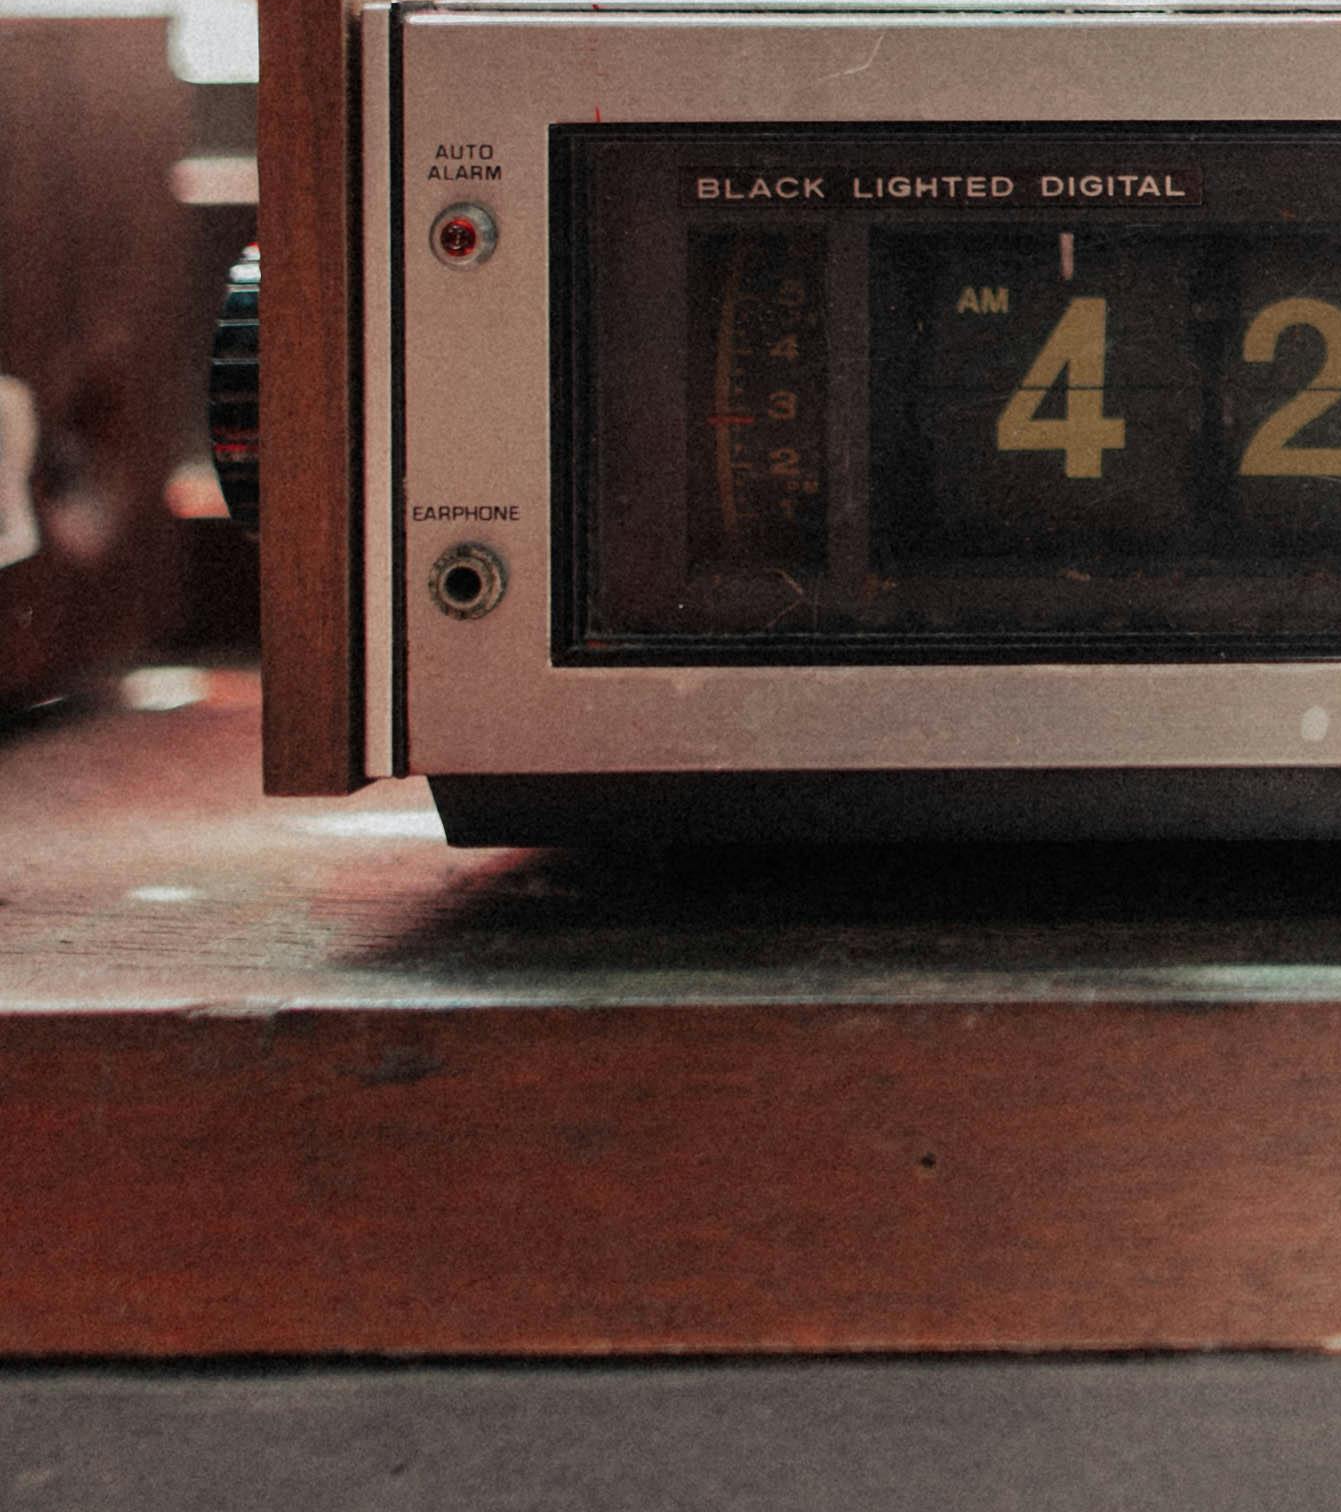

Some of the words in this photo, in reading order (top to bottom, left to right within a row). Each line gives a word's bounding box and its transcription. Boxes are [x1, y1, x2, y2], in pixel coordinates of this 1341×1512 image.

[434, 143, 494, 160] AUTO
[428, 164, 502, 181] ALARM
[697, 177, 825, 199] BLACK
[853, 176, 1015, 198] LIGHTED
[1041, 175, 1186, 197] DIGITAL
[957, 288, 1009, 314] AM
[997, 297, 1126, 478] 4
[767, 390, 798, 422] 3
[768, 446, 802, 476] 2
[412, 506, 520, 522] EARPHONE
